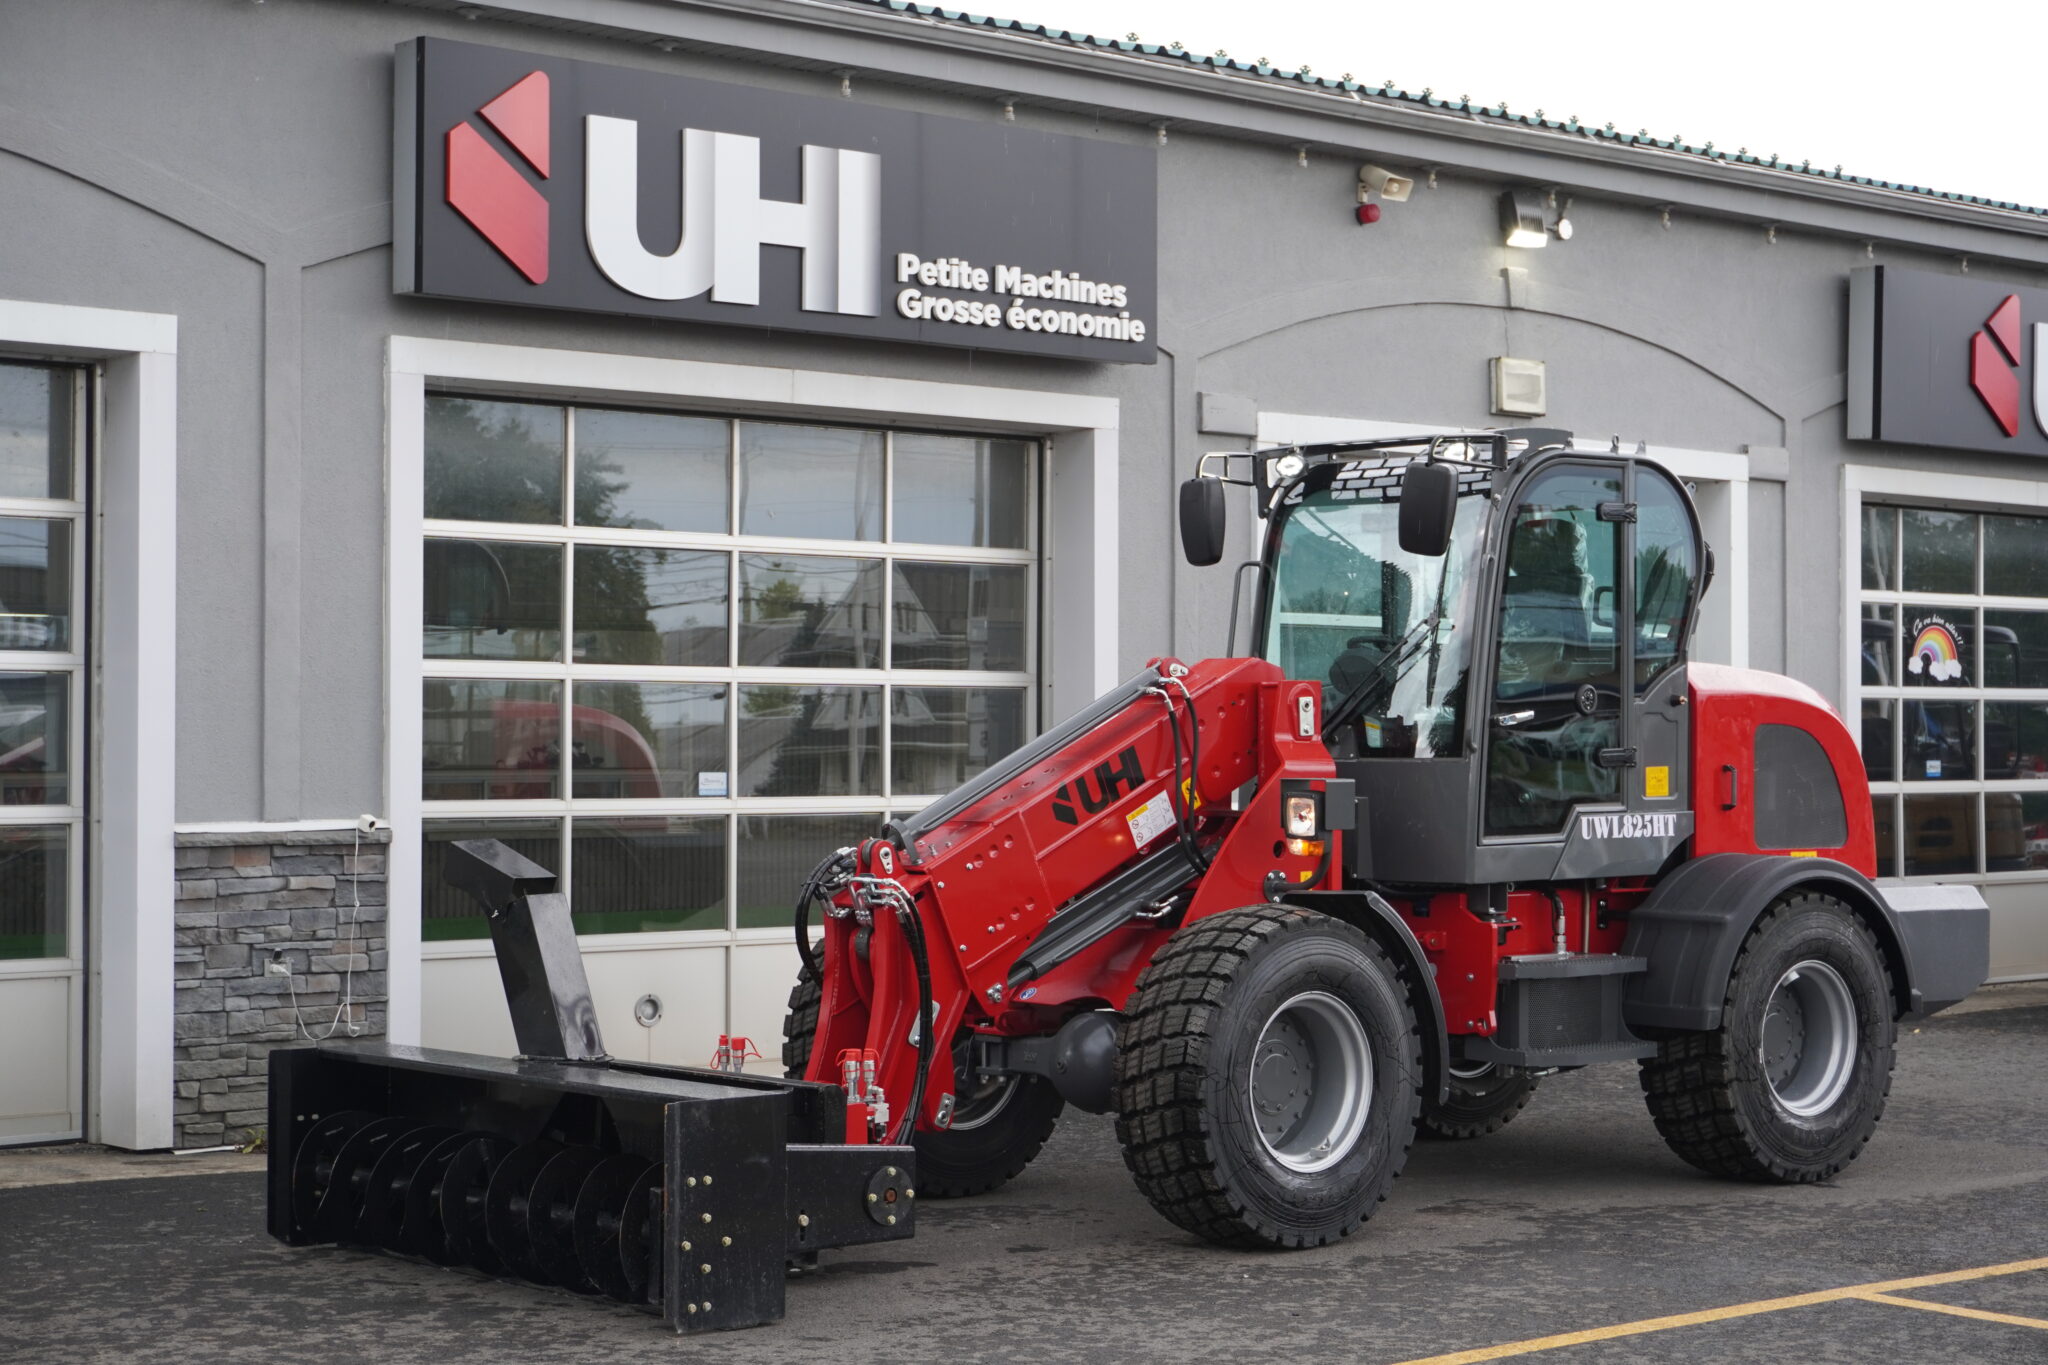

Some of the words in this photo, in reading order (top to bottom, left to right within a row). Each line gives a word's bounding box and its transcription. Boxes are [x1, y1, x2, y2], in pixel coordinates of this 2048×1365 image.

[585, 114, 881, 317] UHI
[897, 253, 989, 291] Petite
[995, 264, 1127, 307] Machines
[897, 288, 1001, 327] Grosse
[1006, 298, 1146, 342] économie
[1932, 614, 1944, 624] bien
[1580, 814, 1677, 840] UWL825HT
